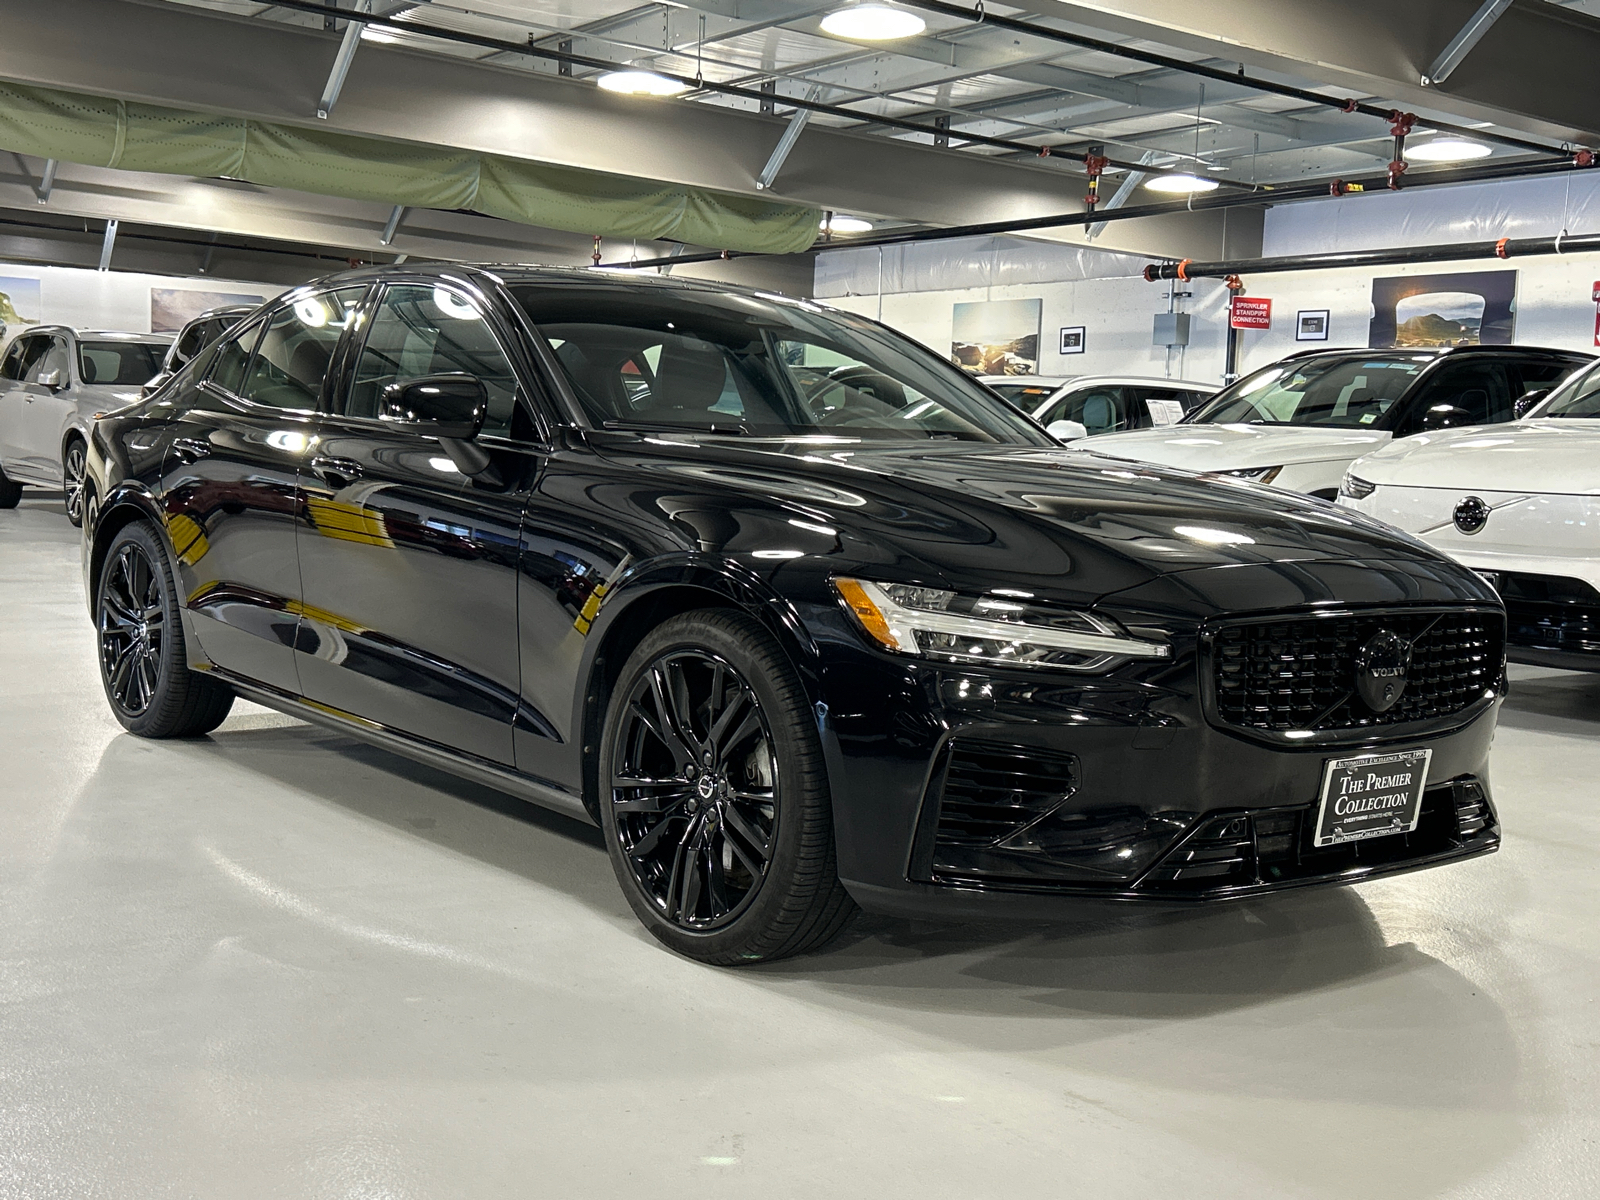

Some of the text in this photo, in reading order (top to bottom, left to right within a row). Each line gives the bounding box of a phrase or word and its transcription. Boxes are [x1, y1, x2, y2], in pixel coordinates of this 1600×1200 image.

[1236, 302, 1268, 310] SPRINKLER
[1236, 309, 1267, 317] STANDPIPE
[1232, 316, 1269, 324] CONNECTION
[1371, 667, 1405, 677] VOLVO
[1369, 755, 1398, 764] EXCELLENCE
[1398, 752, 1412, 760] SINCE
[1339, 773, 1412, 795] THE PREMIER
[1334, 792, 1409, 816] COLLECTION
[1343, 815, 1368, 824] EVERYTHING
